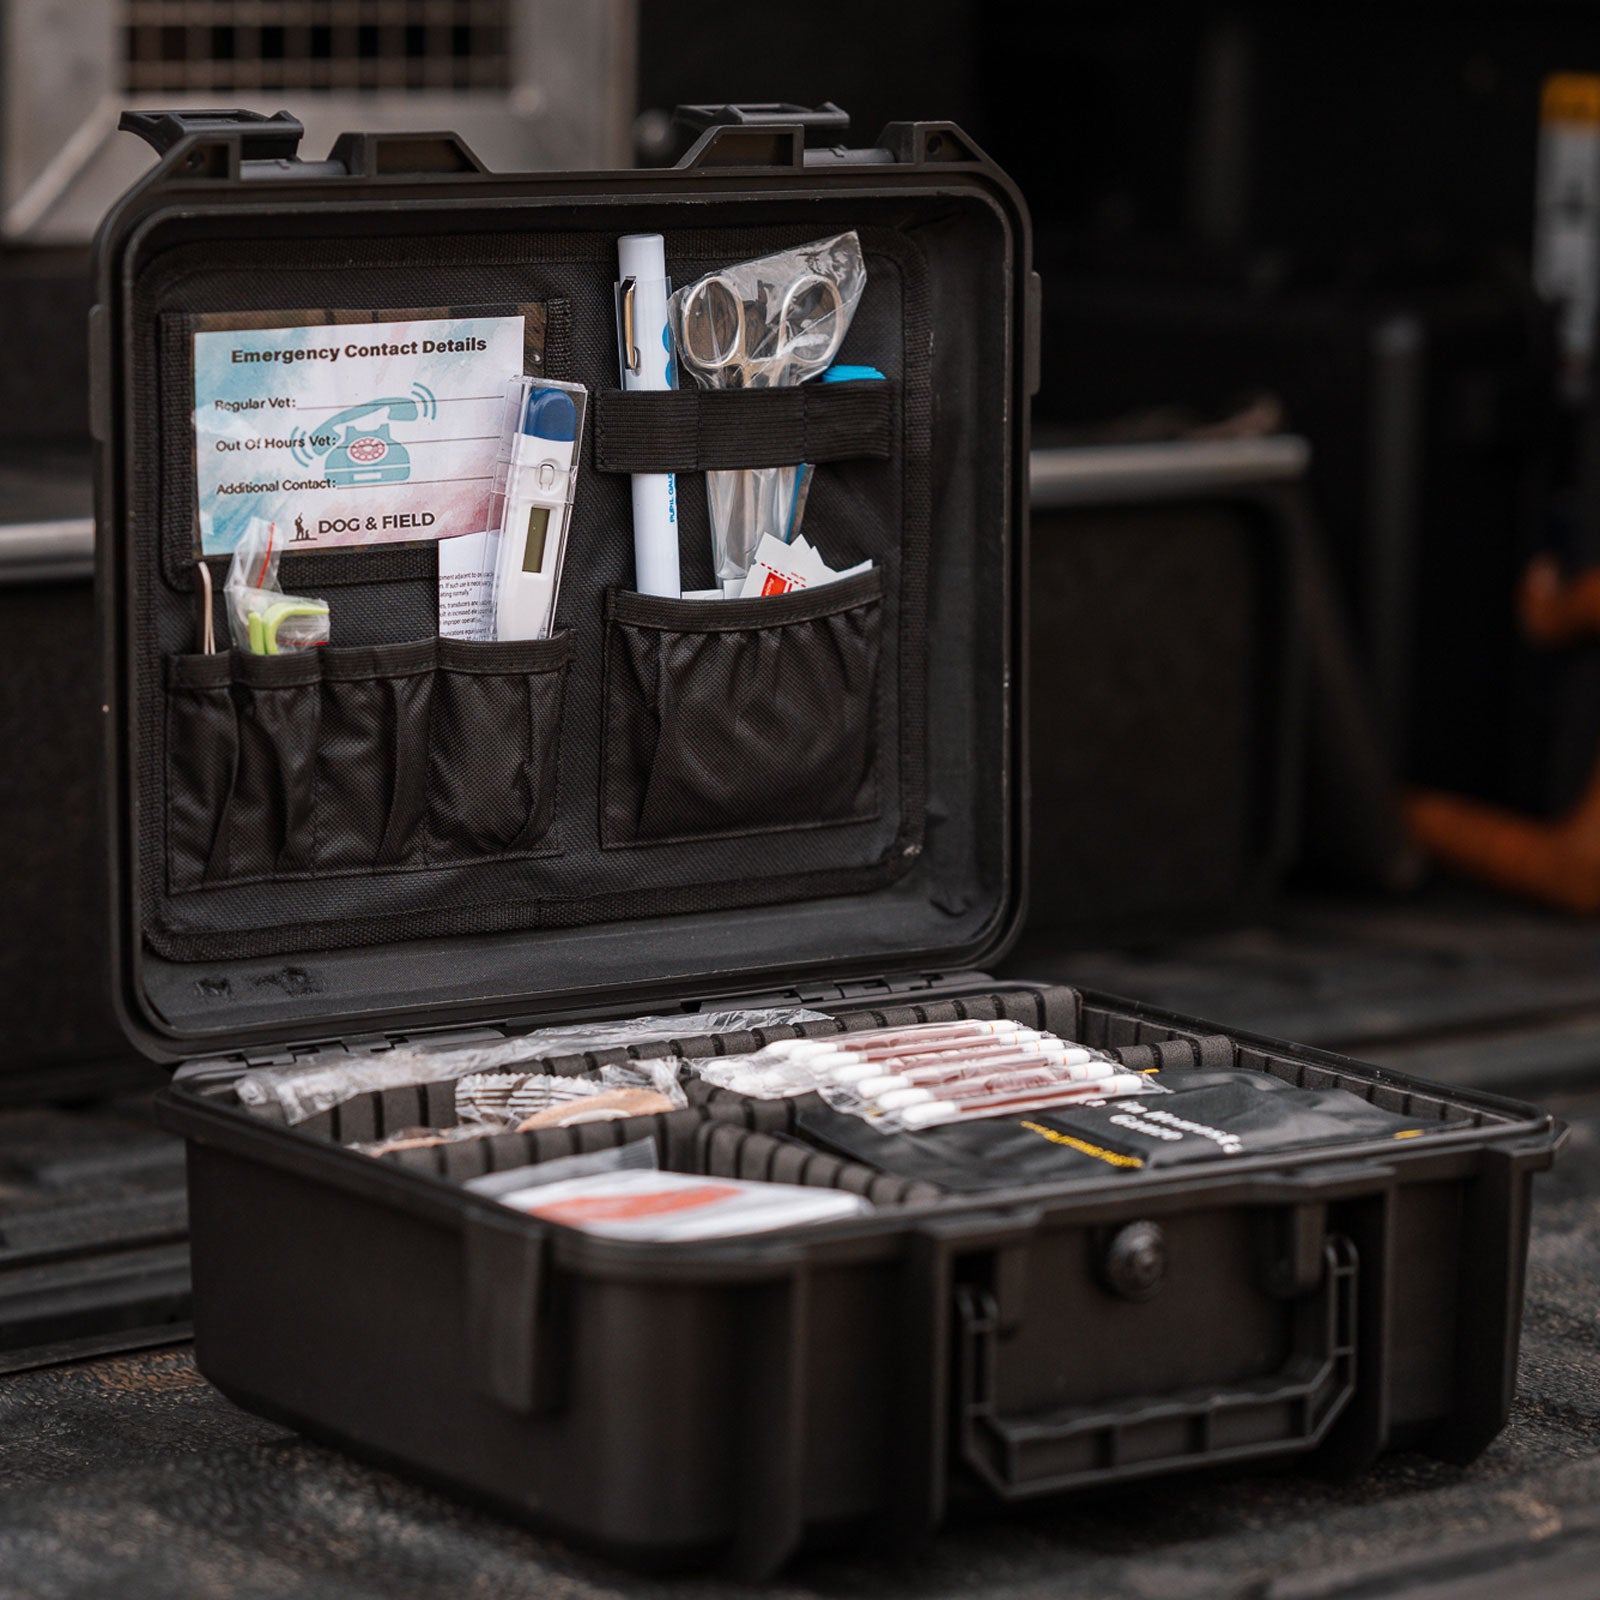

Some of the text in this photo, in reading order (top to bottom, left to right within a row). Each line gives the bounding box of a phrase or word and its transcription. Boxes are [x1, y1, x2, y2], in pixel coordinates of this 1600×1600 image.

[231, 337, 487, 365] Emergency Contact Details
[215, 397, 296, 413] Regular Vet:
[215, 435, 336, 452] Out Of Hours Vet:
[216, 479, 336, 495] Additional Contact:
[318, 512, 435, 534] DOG & FIELD
